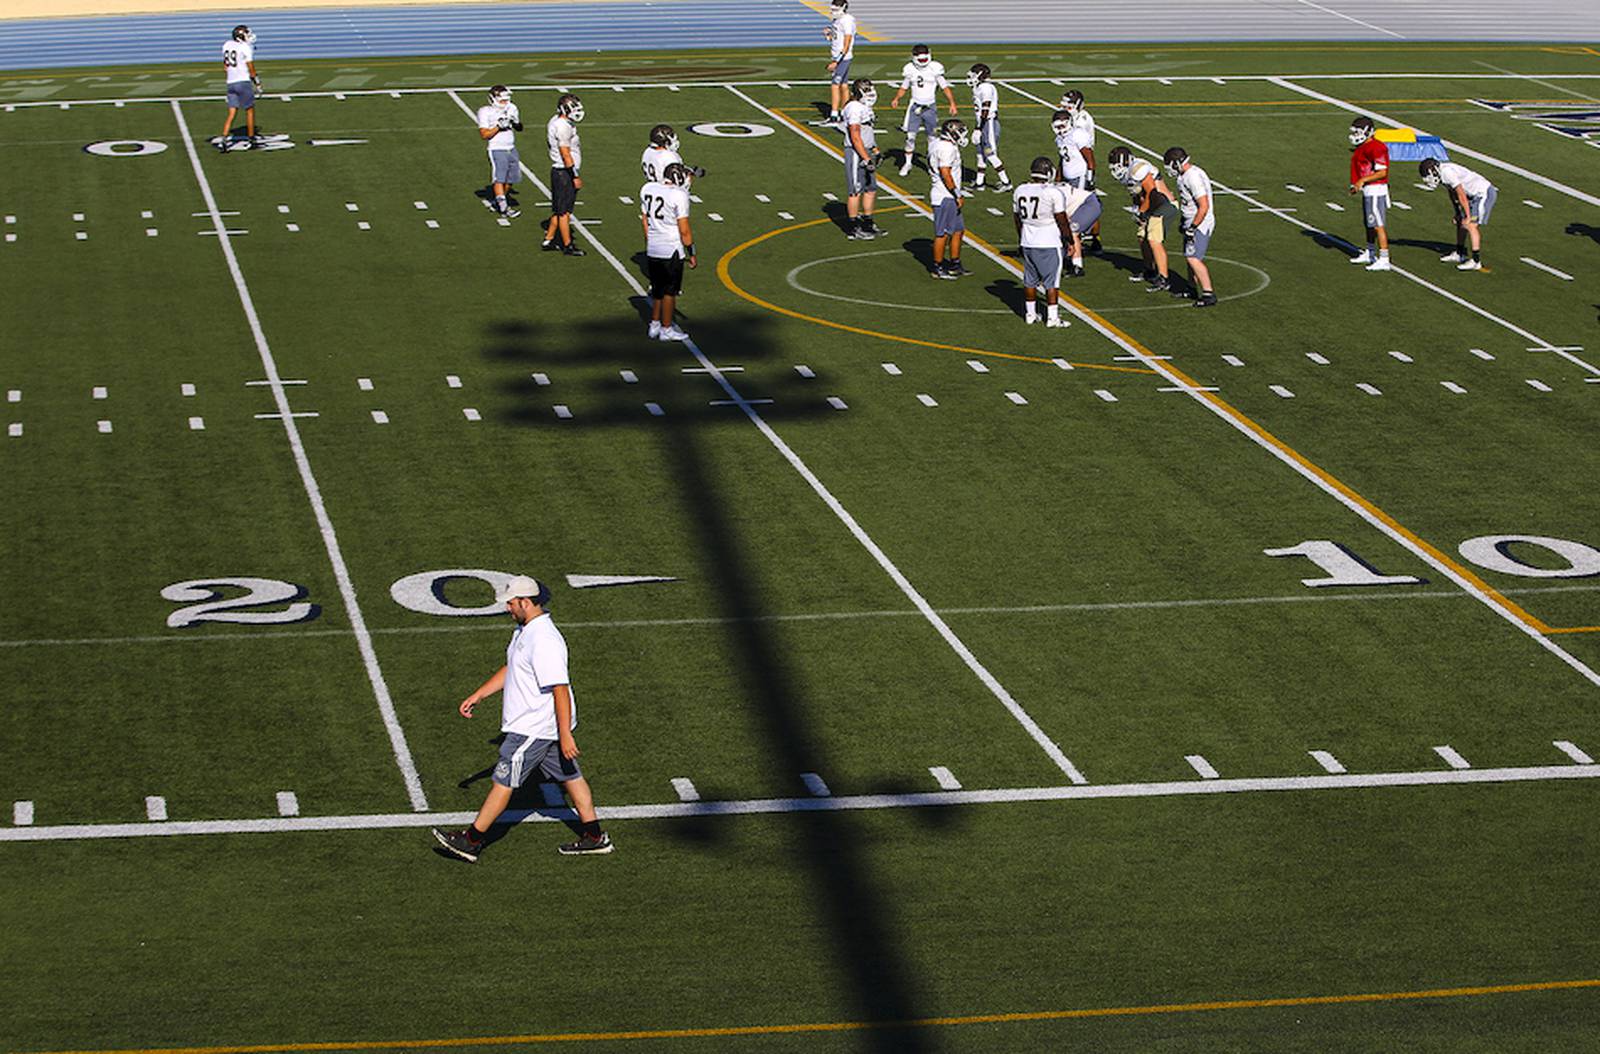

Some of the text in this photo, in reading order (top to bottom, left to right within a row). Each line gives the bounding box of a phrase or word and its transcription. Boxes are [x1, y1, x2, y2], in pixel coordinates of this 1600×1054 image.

[224, 50, 237, 67] 89
[916, 75, 925, 89] 2
[644, 194, 665, 220] 72
[1018, 196, 1040, 220] 67
